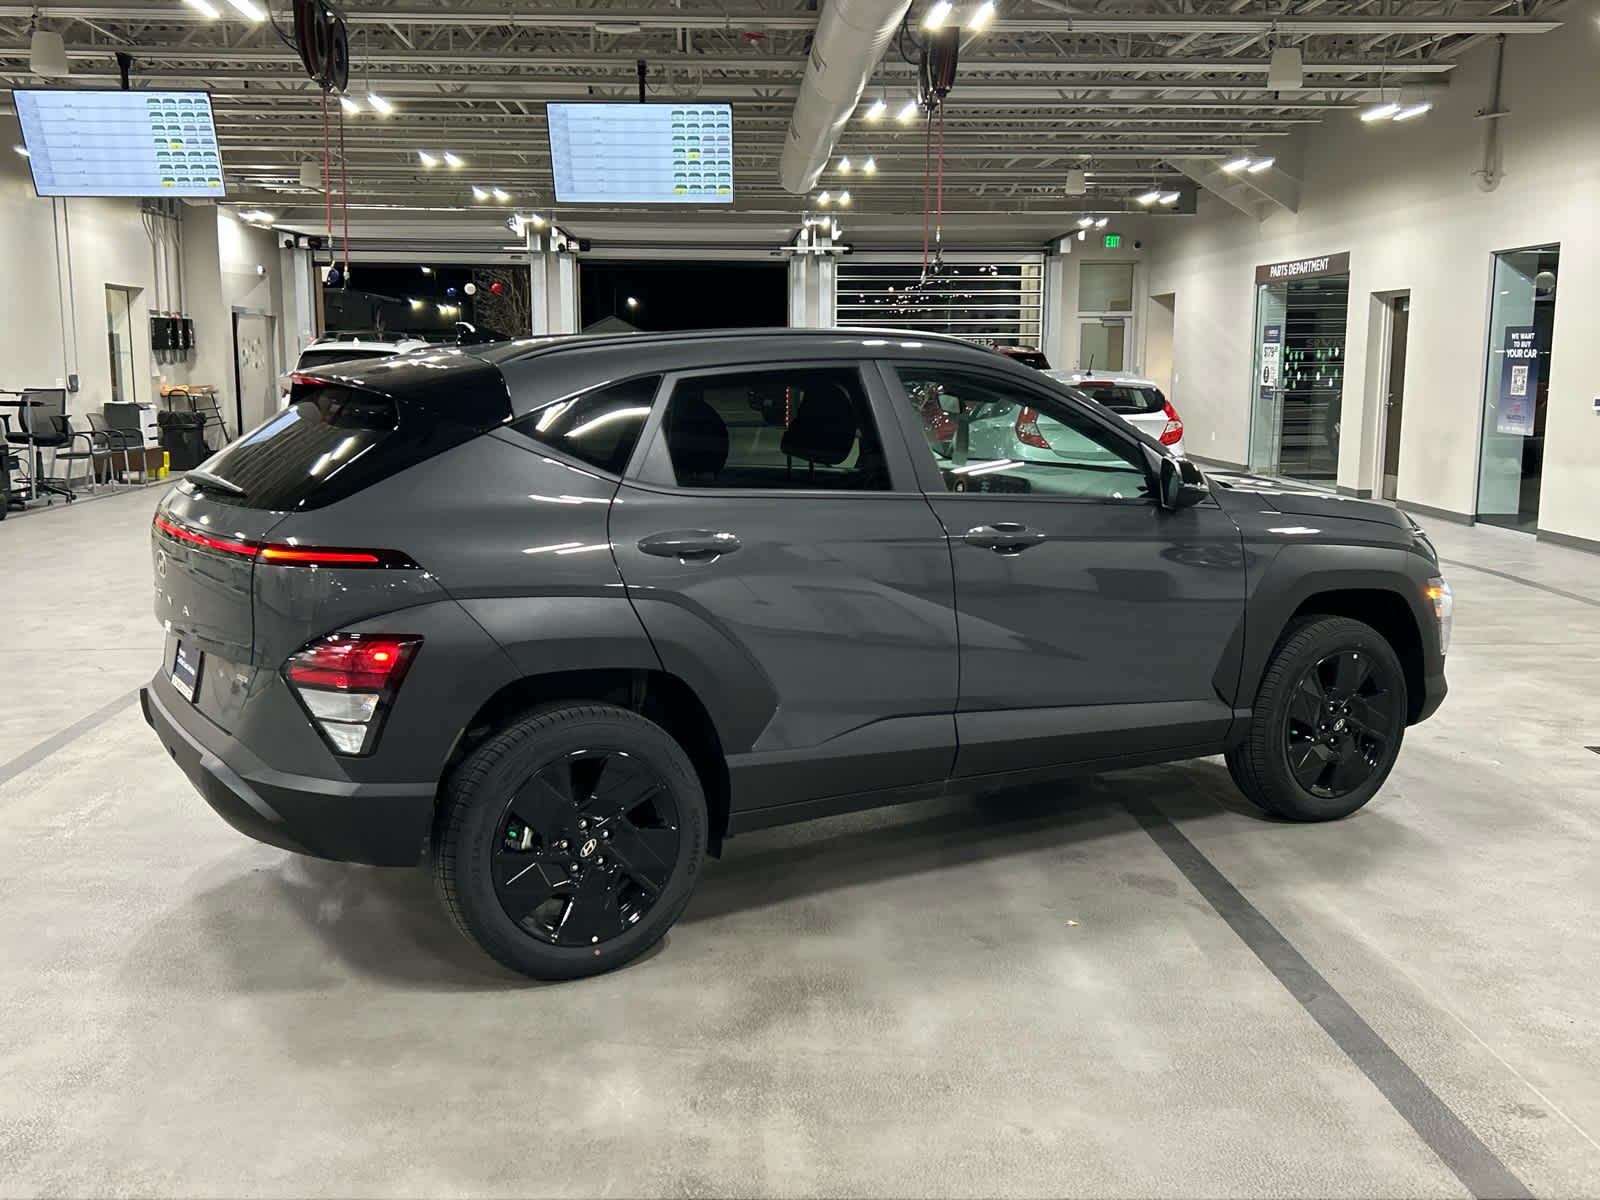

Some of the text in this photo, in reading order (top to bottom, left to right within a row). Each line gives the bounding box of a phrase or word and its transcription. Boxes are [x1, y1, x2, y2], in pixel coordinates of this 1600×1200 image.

[1105, 235, 1120, 248] EXIT
[1270, 258, 1329, 277] PARTS DEPARTMENT
[1520, 332, 1535, 340] WANT
[1506, 348, 1538, 359] YOUR CAR
